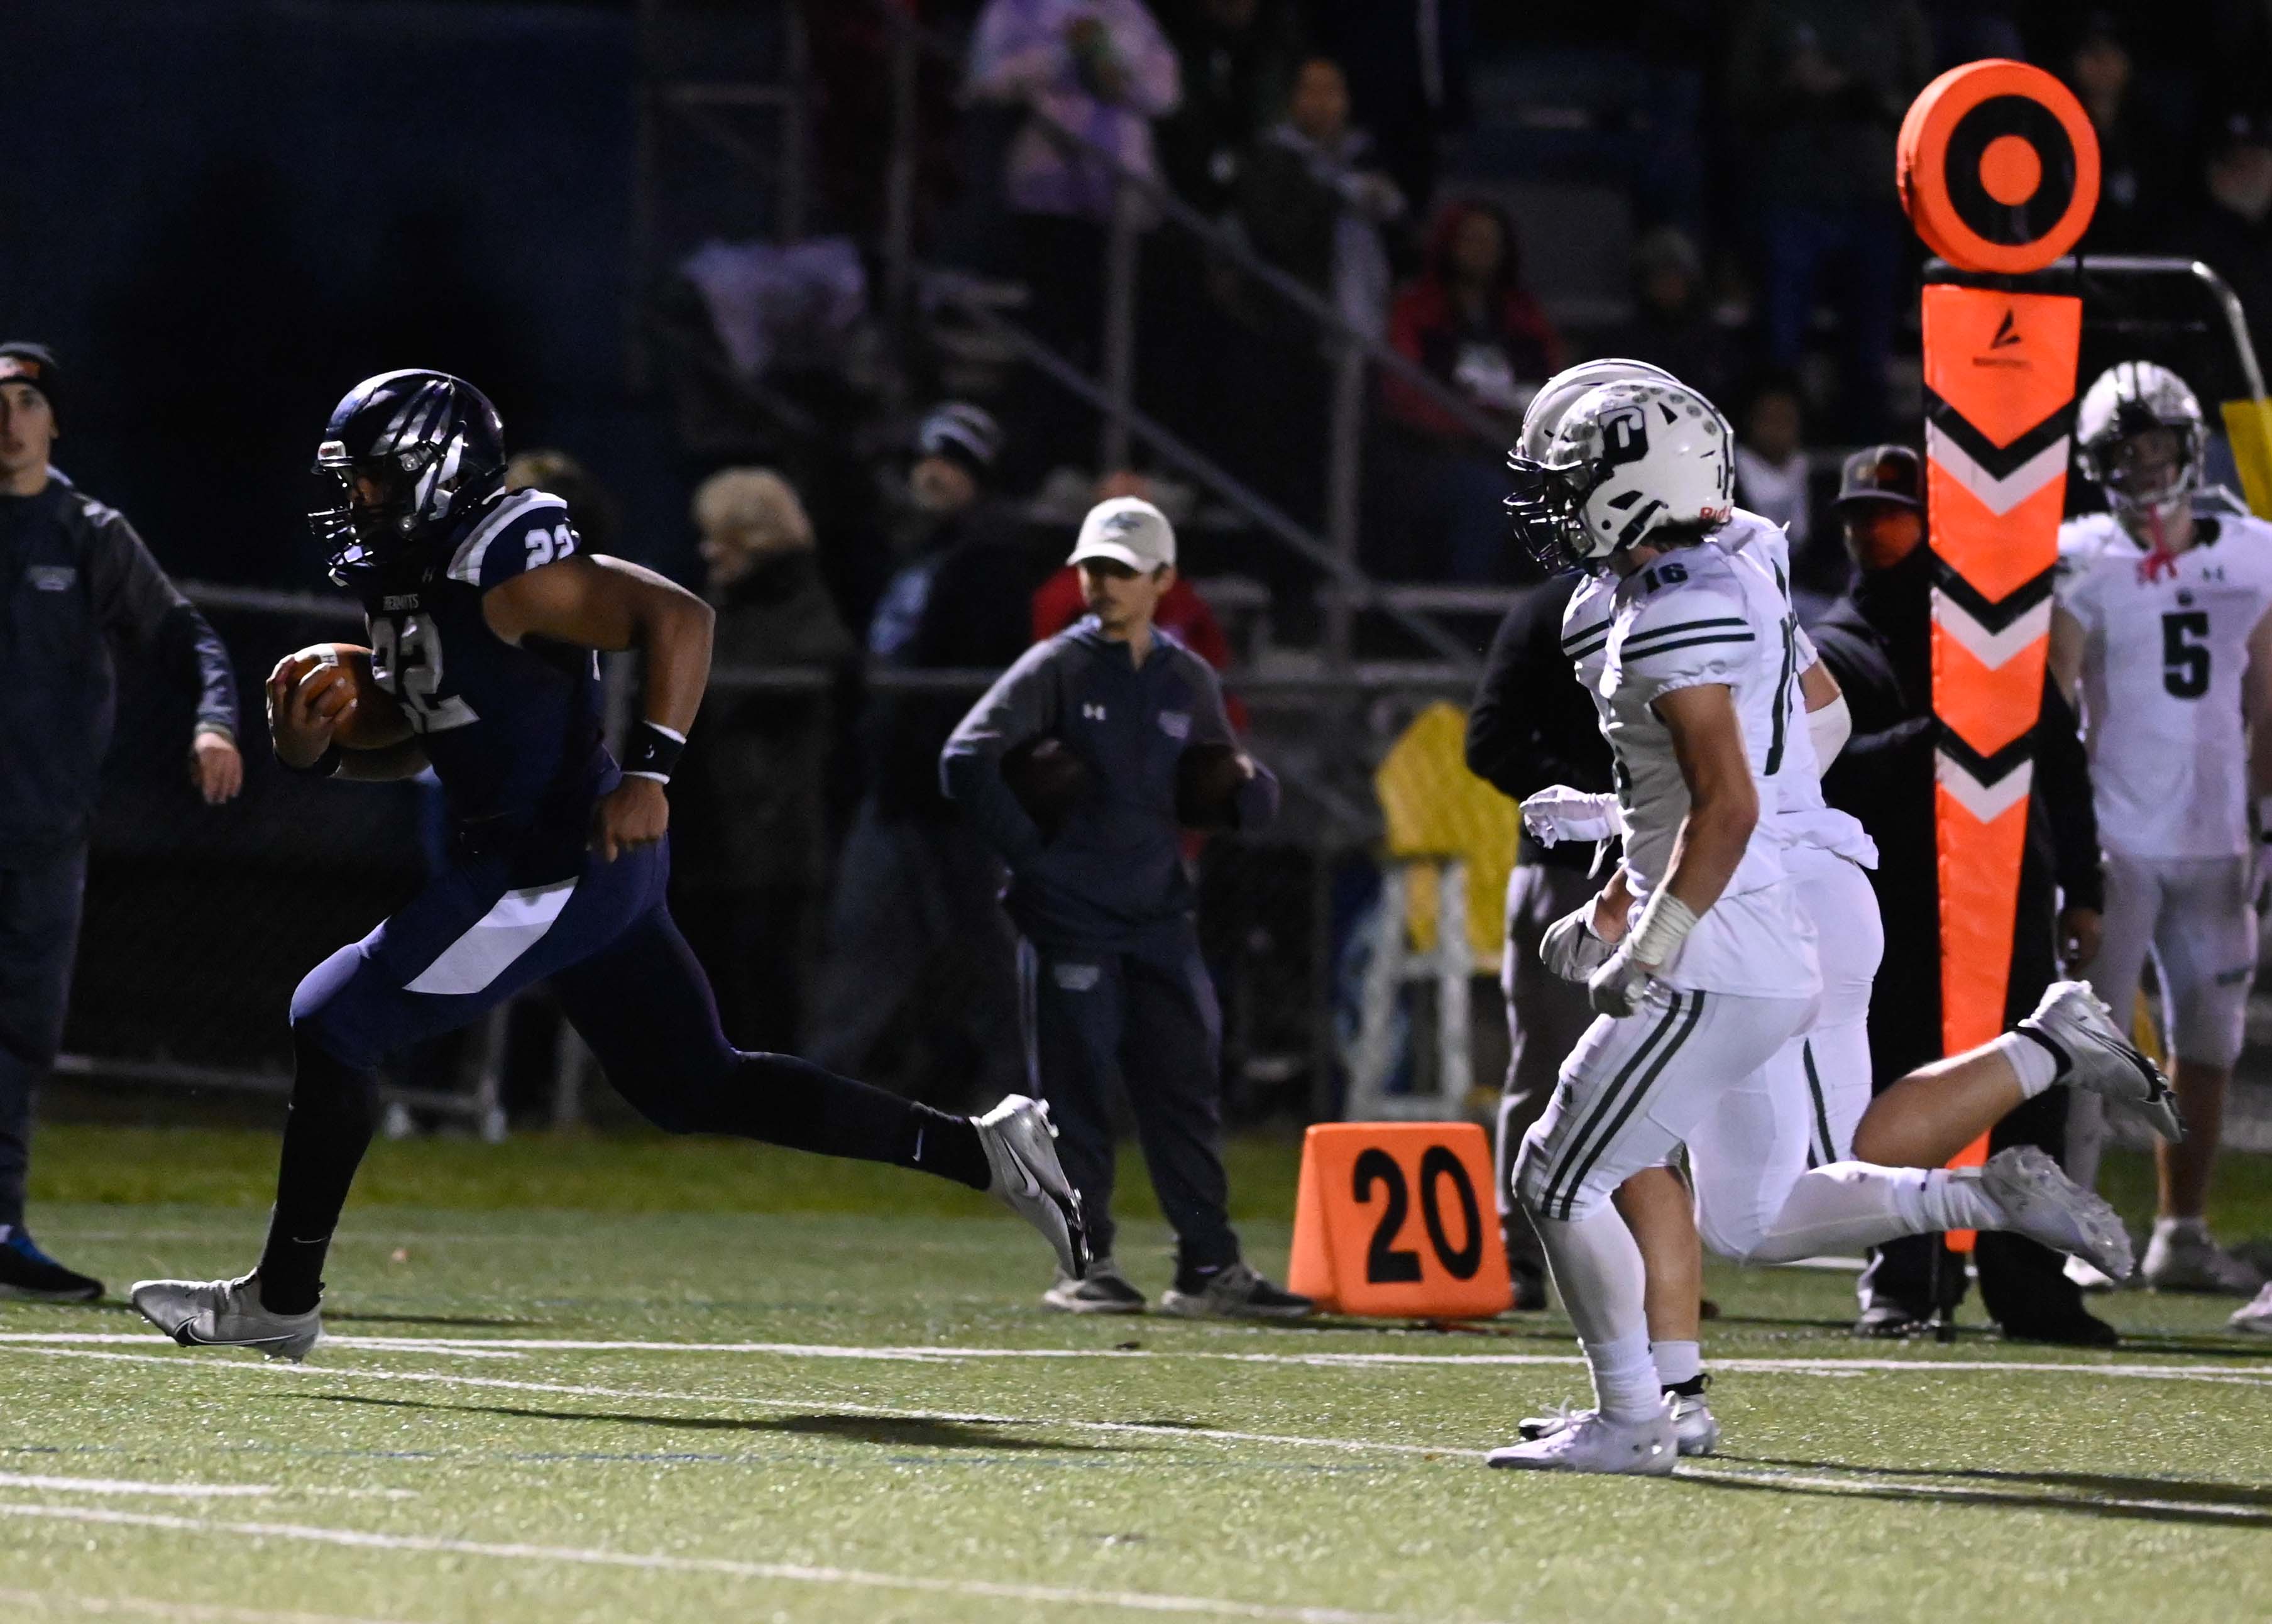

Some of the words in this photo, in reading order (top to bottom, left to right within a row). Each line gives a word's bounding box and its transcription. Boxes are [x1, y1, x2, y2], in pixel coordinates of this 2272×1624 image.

[1644, 563, 1688, 594] 16
[2162, 612, 2210, 699] 5
[1354, 1147, 1482, 1283] 20
